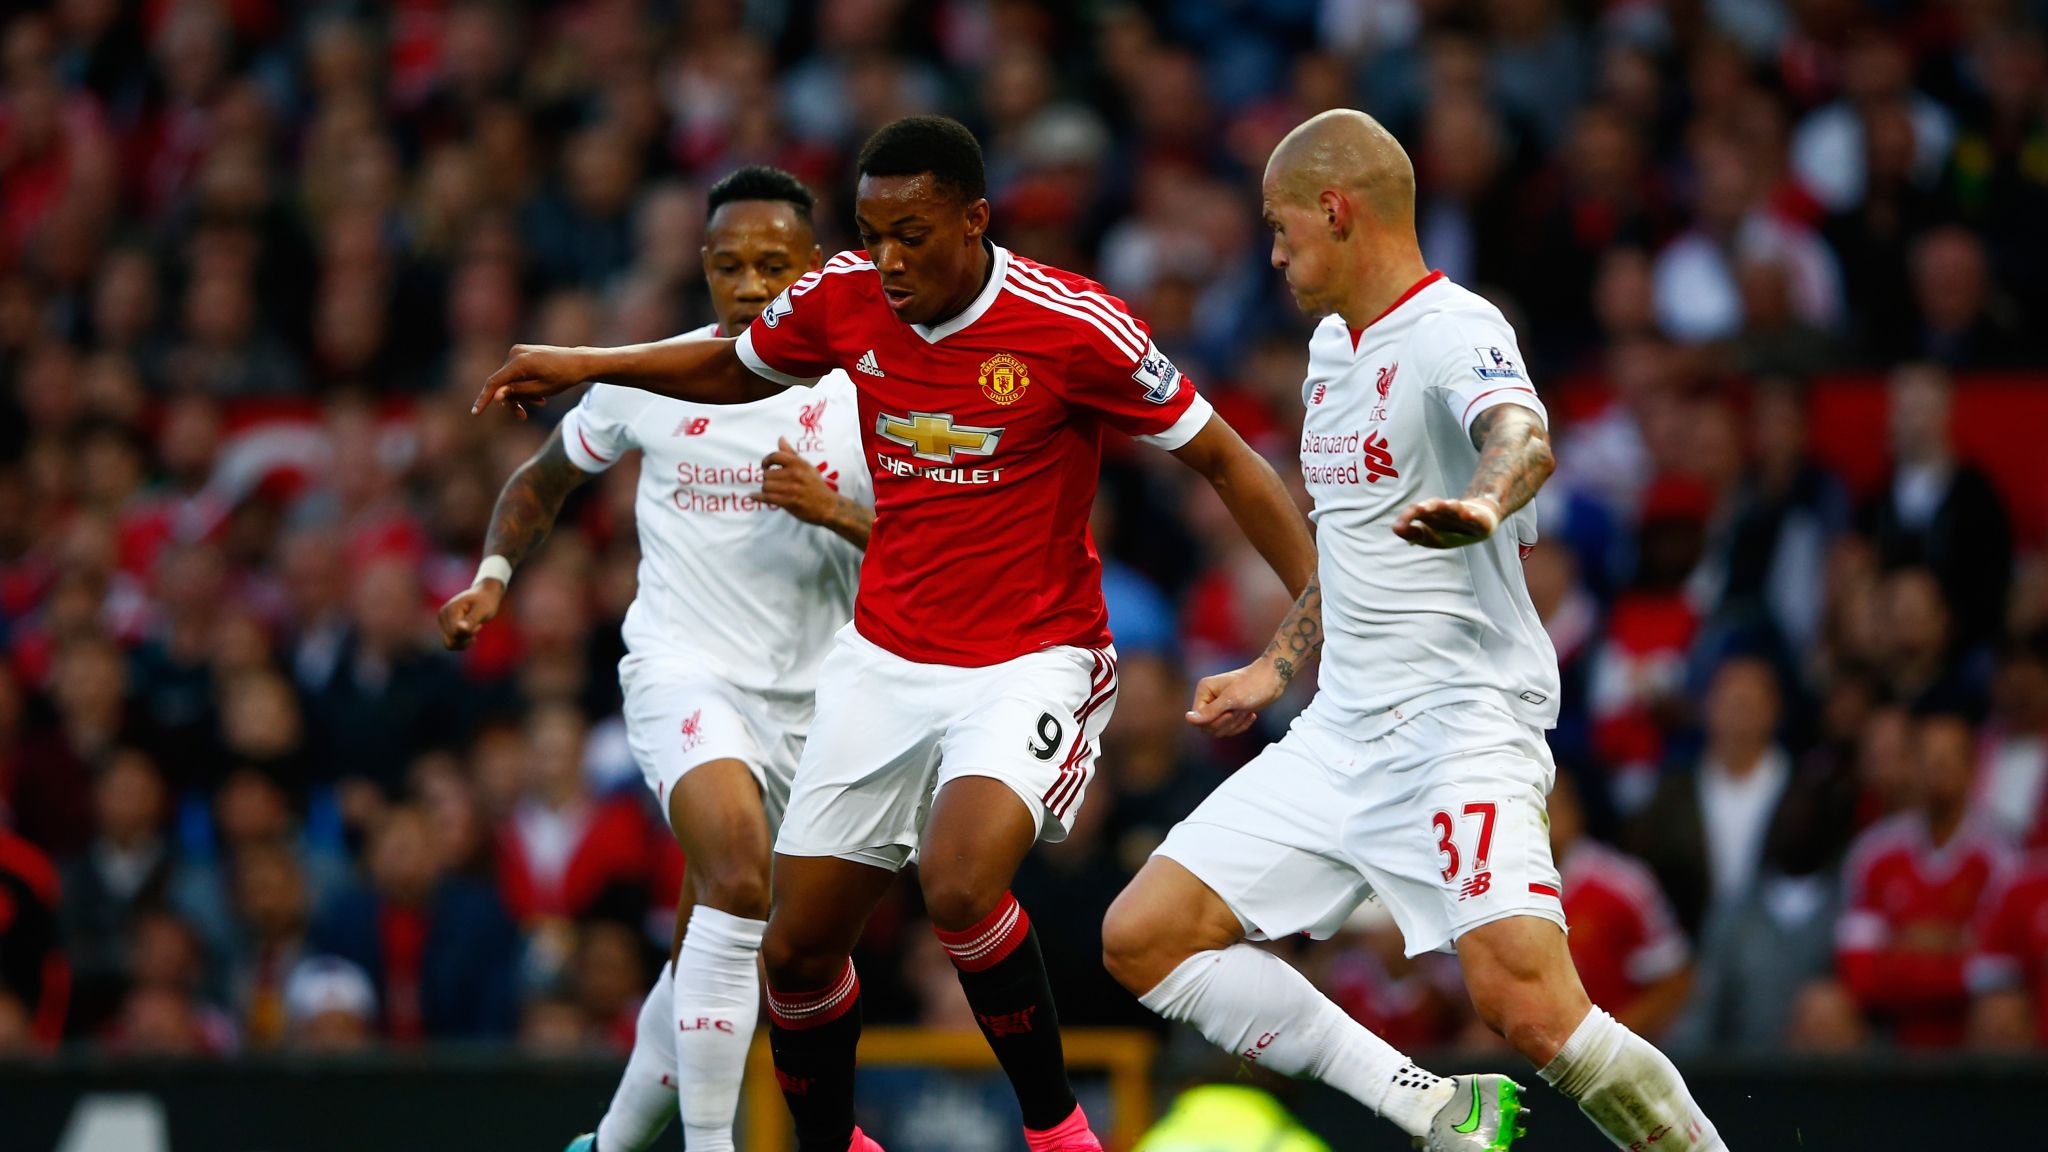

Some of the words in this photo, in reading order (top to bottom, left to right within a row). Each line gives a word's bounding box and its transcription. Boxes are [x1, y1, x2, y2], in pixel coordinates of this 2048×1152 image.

[856, 363, 885, 377] adidas
[984, 356, 1025, 374] MANCHESTER
[990, 392, 1019, 402] UNITED
[1302, 430, 1359, 454] Standard
[677, 462, 764, 486] Standa
[877, 452, 1005, 485] CHEVROLET
[1300, 461, 1360, 485] hartered
[1027, 710, 1064, 762] 9
[1432, 801, 1499, 884] 37
